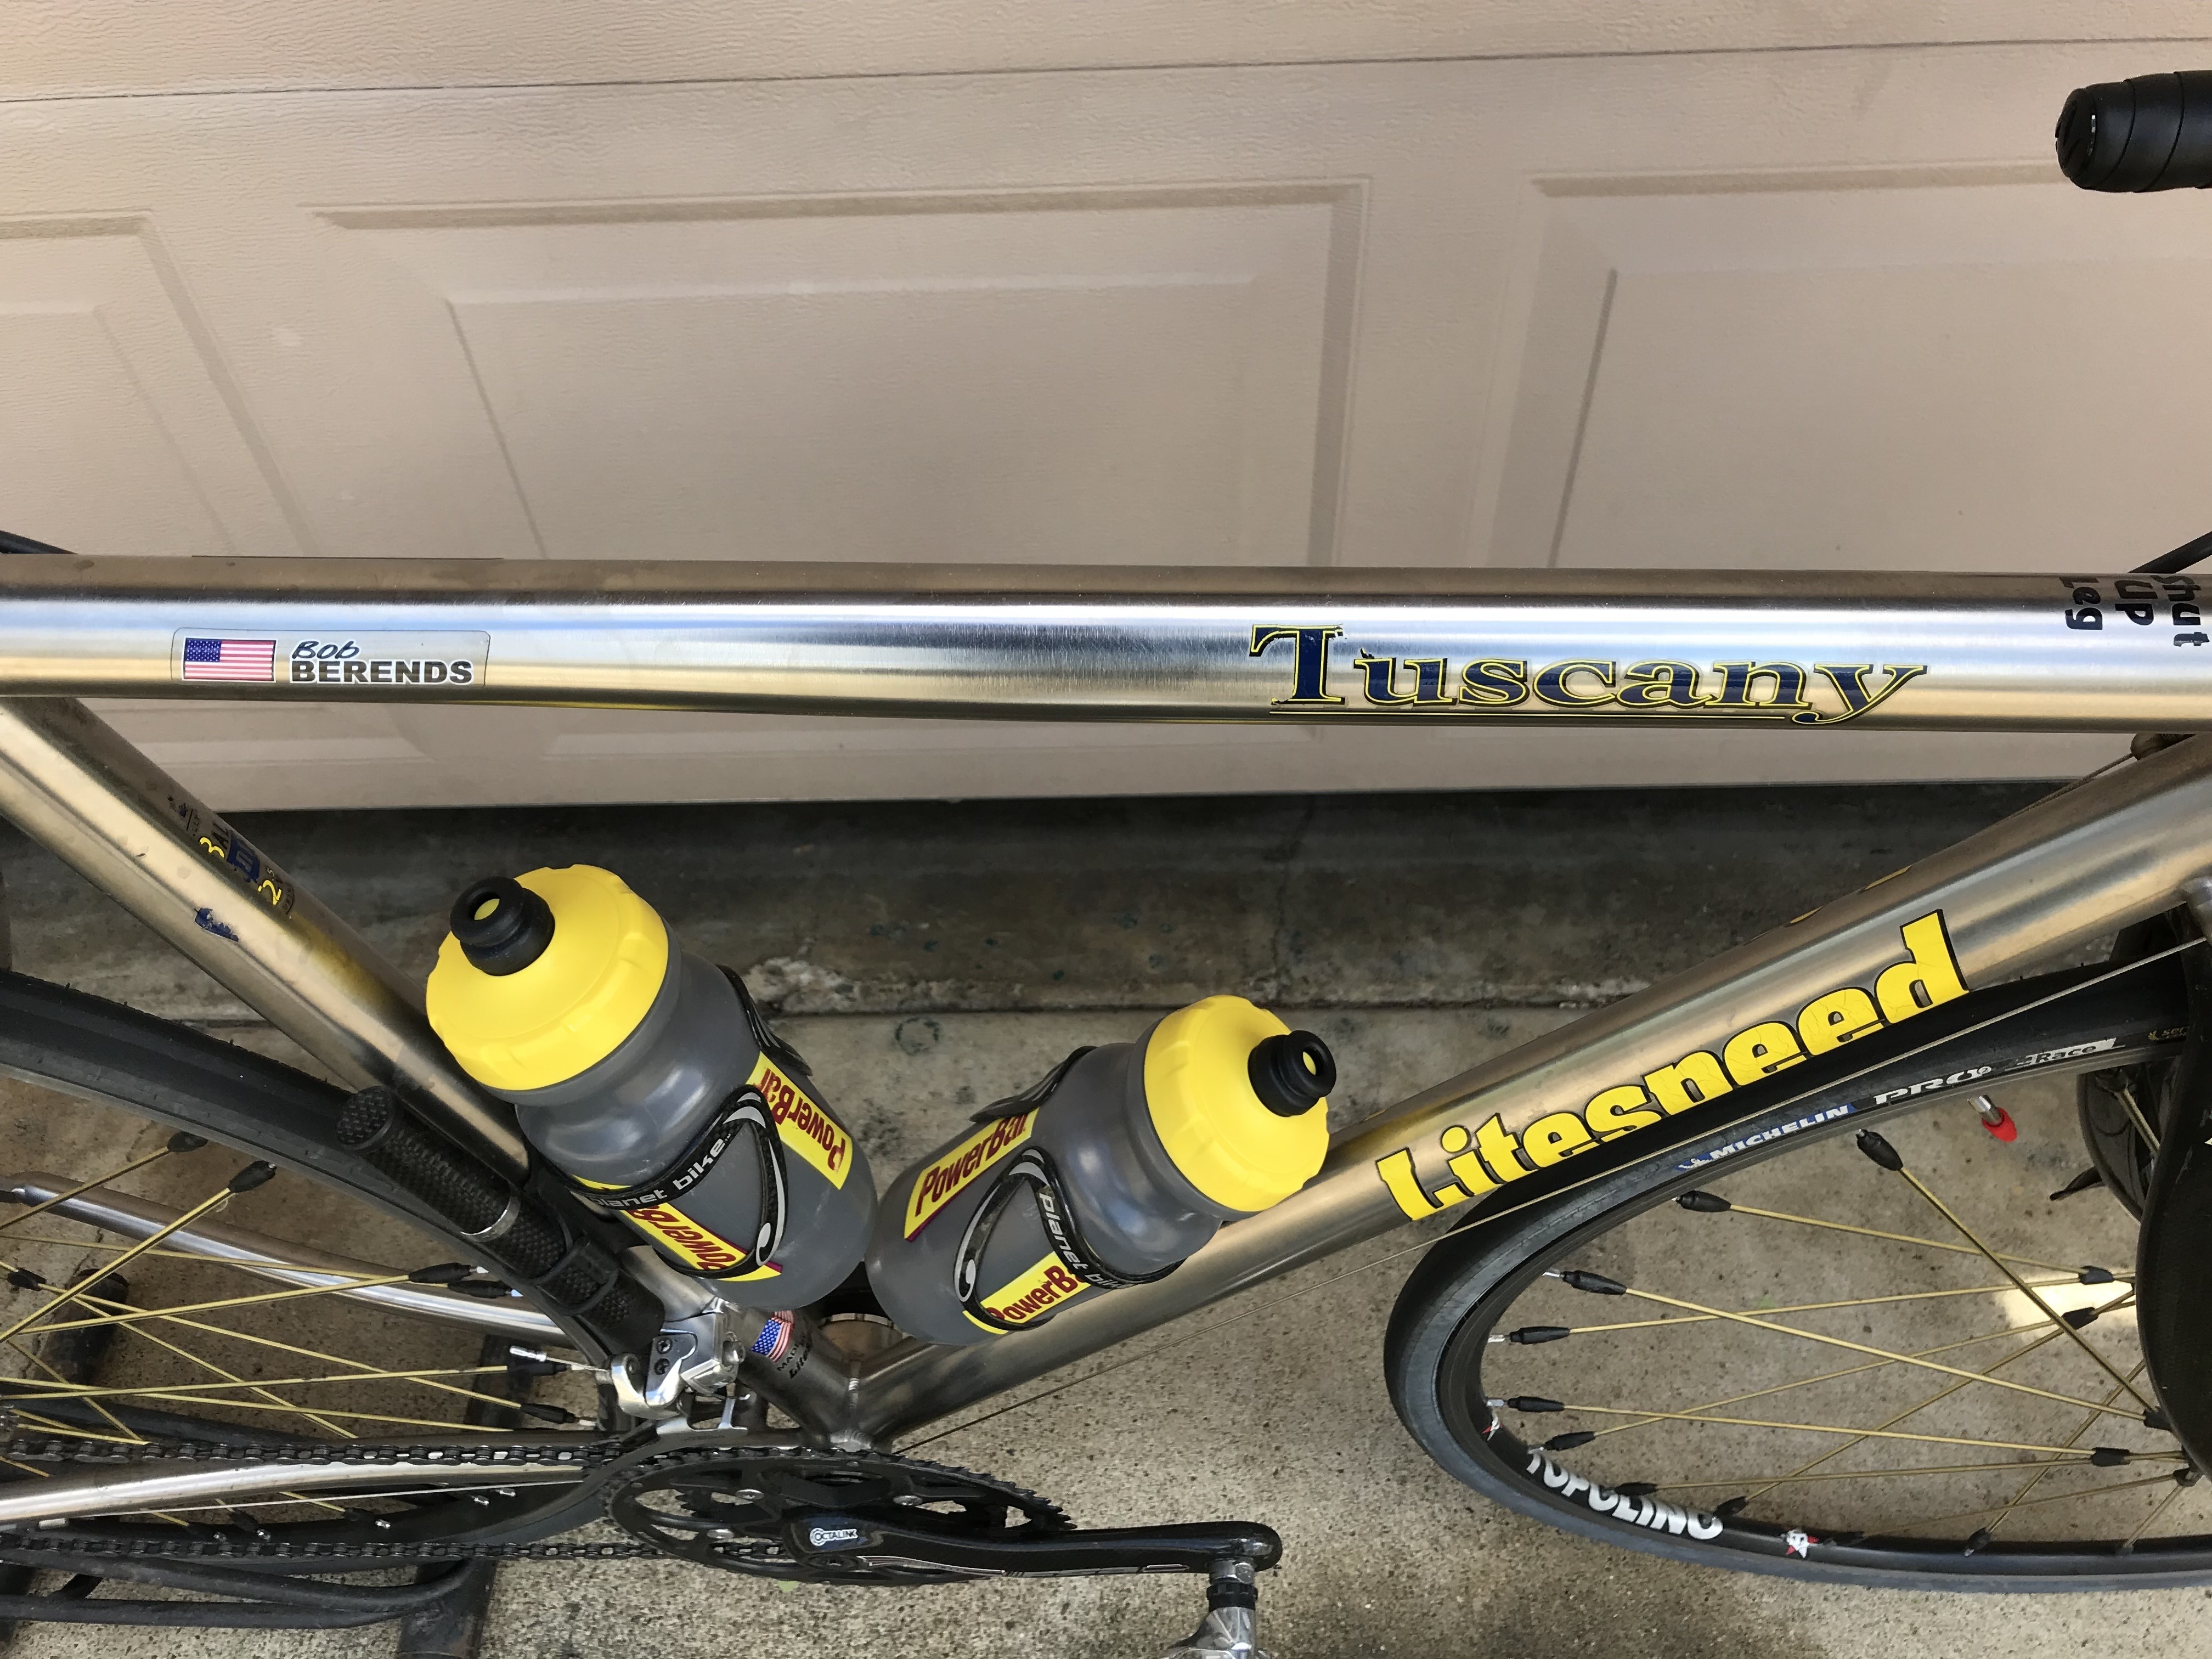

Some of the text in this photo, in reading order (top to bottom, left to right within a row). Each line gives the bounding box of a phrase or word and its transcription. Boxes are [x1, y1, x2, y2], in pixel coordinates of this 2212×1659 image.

[290, 661, 473, 684] BERENDS
[291, 640, 360, 659] Bob
[1250, 624, 1928, 725] Tuscany
[1709, 1104, 1850, 1160] MICHELIN
[2035, 1045, 2097, 1063] Race
[1039, 1193, 1088, 1270] planet
